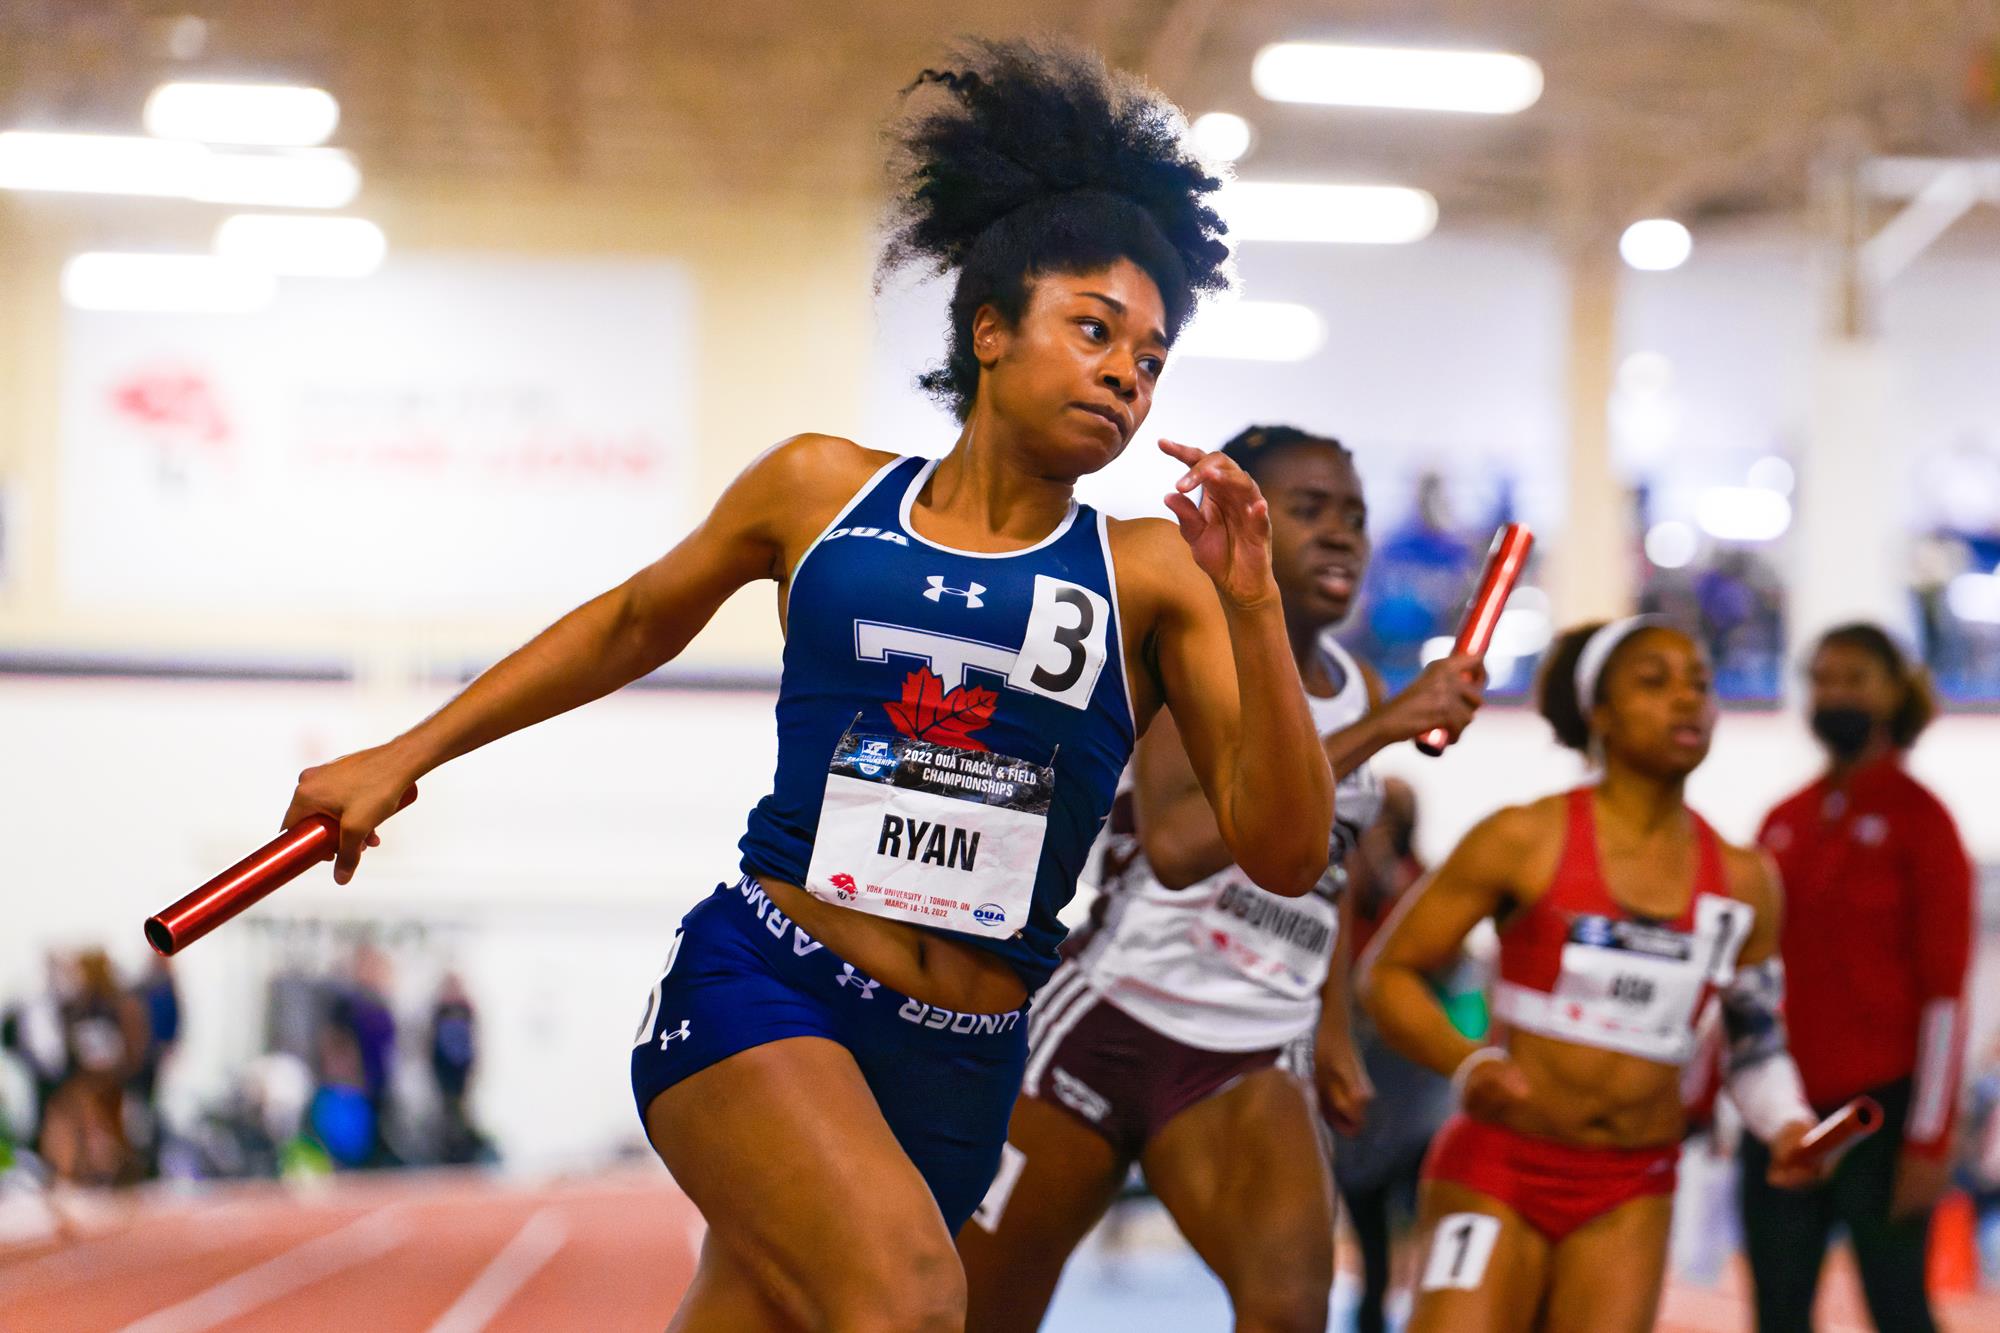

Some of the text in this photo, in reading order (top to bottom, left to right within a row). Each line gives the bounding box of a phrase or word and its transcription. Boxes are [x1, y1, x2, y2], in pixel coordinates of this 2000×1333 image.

[823, 526, 910, 547] OUA
[1030, 586, 1094, 693] 3
[903, 749, 932, 765] 2022
[935, 753, 956, 769] OUA
[959, 758, 993, 777] TRACK
[996, 767, 1005, 779] &
[1007, 768, 1038, 786] FIELD
[922, 768, 1014, 797] CHAMPIONSHIPS
[877, 813, 981, 872] RYAN
[836, 890, 847, 900] YU
[866, 884, 883, 895] YORK
[884, 888, 922, 902] UNIVERSITY
[929, 896, 958, 910] TORONTO,
[960, 902, 971, 911] ON
[884, 899, 908, 909] MARCH
[931, 908, 948, 918] 2022
[973, 909, 1005, 922] OUA
[740, 875, 1020, 1034] UNDER ARMO
[1708, 912, 1733, 977] 1
[1449, 1222, 1473, 1279] 1
